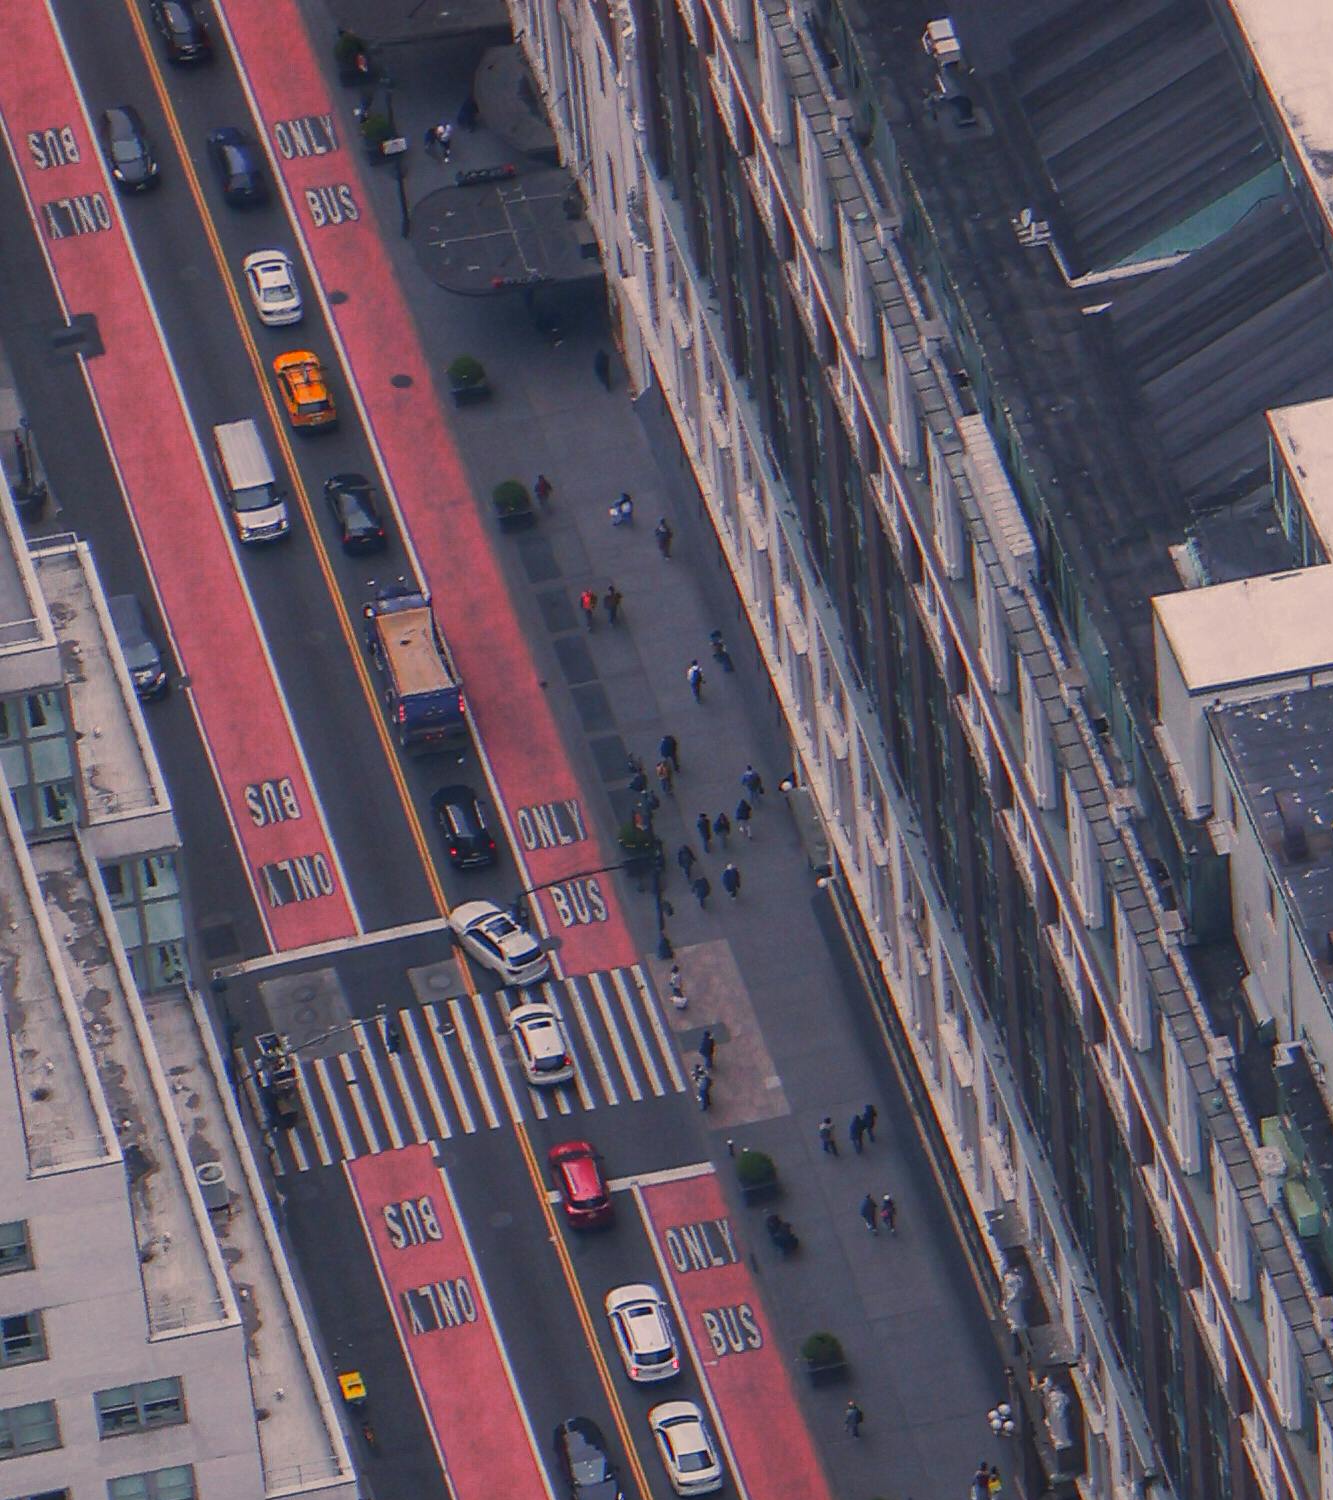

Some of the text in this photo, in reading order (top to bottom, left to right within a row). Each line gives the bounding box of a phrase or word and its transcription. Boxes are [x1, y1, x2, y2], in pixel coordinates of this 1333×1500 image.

[27, 126, 81, 169] BUS
[273, 115, 340, 160] ONLY
[305, 184, 361, 228] BUS
[246, 778, 301, 824] BUS
[517, 800, 586, 850] ONLY
[259, 854, 334, 907] ONLY
[550, 879, 609, 927] BUS
[384, 1196, 442, 1249] BUS
[664, 1220, 735, 1273] ONLY
[400, 1278, 479, 1335] ONLY
[702, 1304, 762, 1356] BUS
